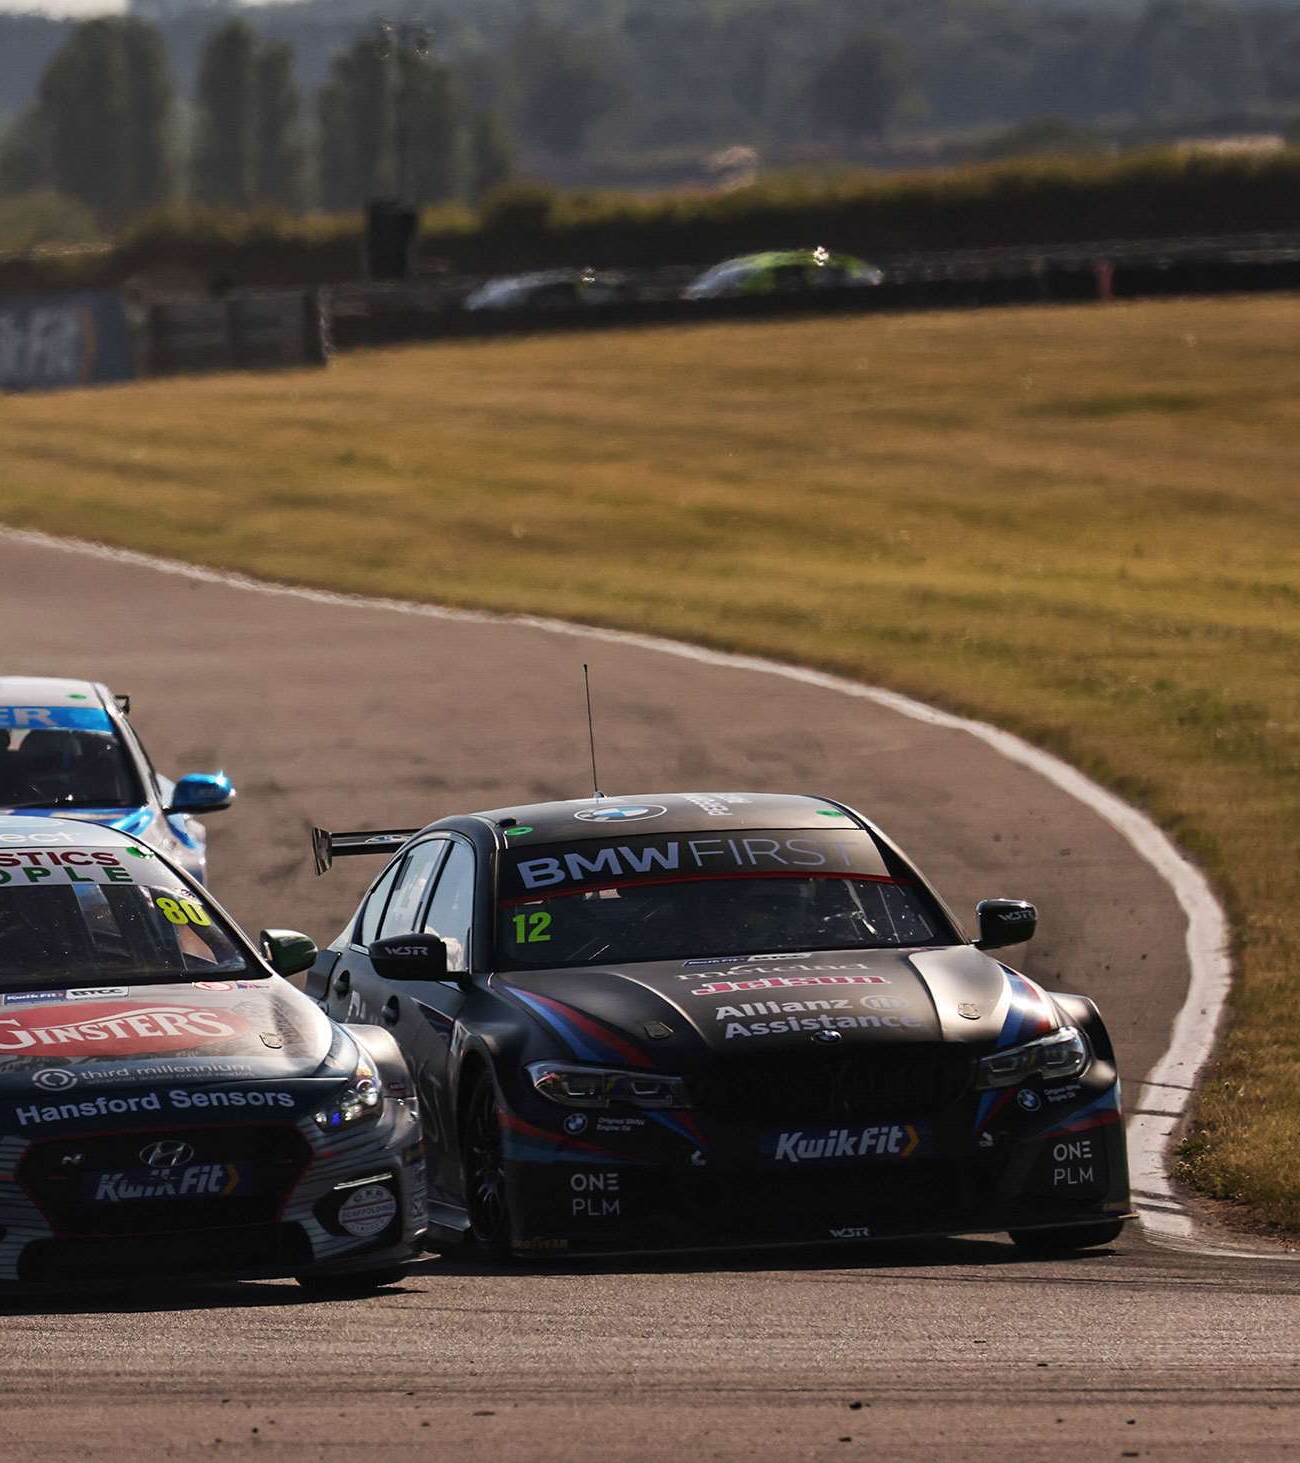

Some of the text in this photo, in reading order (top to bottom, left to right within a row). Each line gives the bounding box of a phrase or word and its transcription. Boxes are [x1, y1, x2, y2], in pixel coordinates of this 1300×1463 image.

[155, 897, 212, 926] 80
[512, 911, 553, 944] 12
[384, 946, 429, 956] WSR
[715, 998, 852, 1021] Allianz
[725, 1013, 925, 1039] Assistance
[81, 1068, 128, 1081] third
[137, 1063, 254, 1075] millennium
[16, 1088, 296, 1126] Hansford Sensors
[1053, 1140, 1093, 1162] ONE
[569, 1172, 620, 1192] ONE
[1054, 1165, 1094, 1186] PLM
[571, 1198, 621, 1217] PLM
[829, 1226, 869, 1238] WSR
